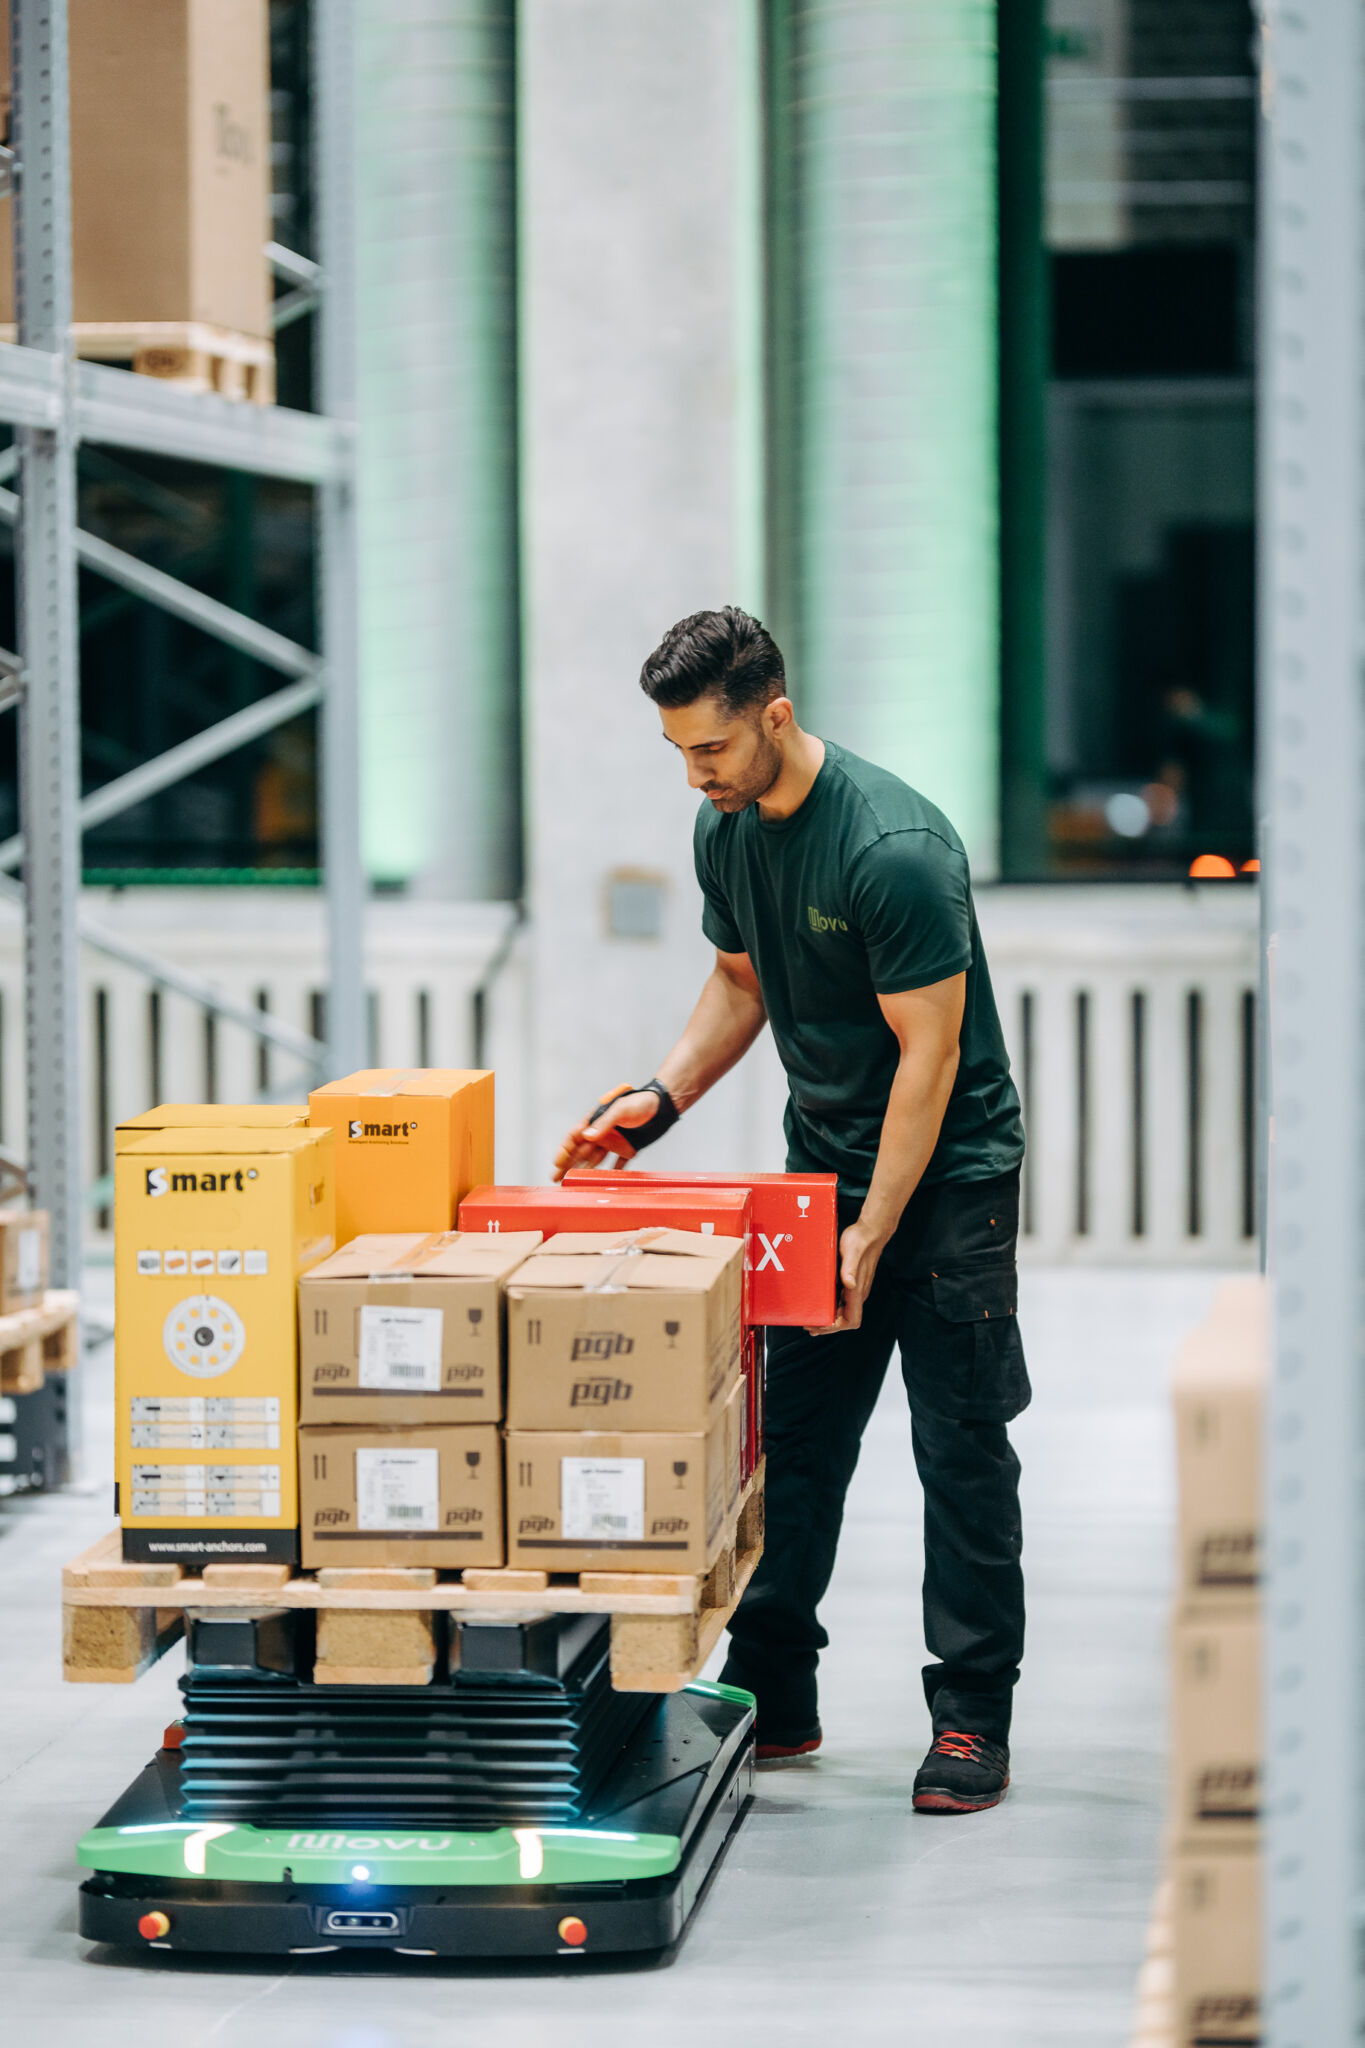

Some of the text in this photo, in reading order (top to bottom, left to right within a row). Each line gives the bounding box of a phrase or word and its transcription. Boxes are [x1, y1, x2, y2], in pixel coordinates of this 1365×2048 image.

[571, 1332, 635, 1361] pgb
[570, 1378, 633, 1407] pgb
[148, 1541, 268, 1553] www.smart-anchors.com
